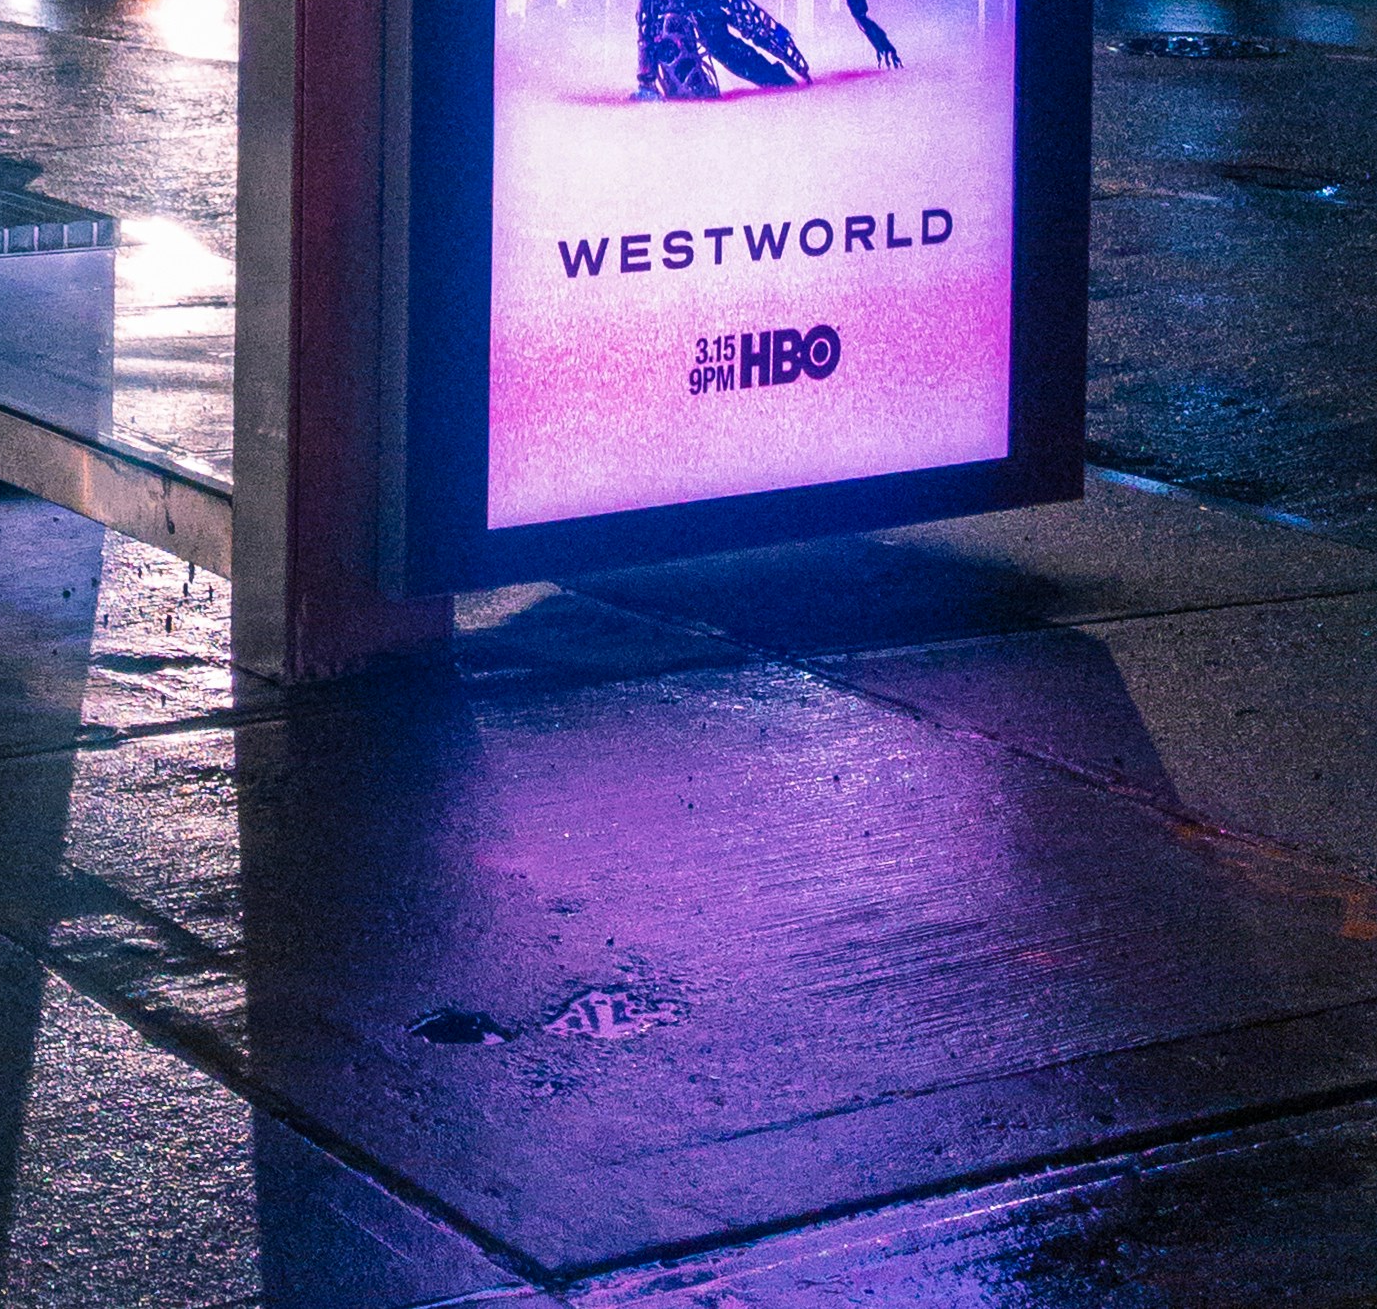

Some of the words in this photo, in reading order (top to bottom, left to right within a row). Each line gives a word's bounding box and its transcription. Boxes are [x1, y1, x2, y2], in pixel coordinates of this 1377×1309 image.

[558, 208, 954, 278] WESTWORLD
[694, 334, 736, 365] 3.15
[739, 324, 841, 390] HBO
[689, 367, 735, 396] 9PM
